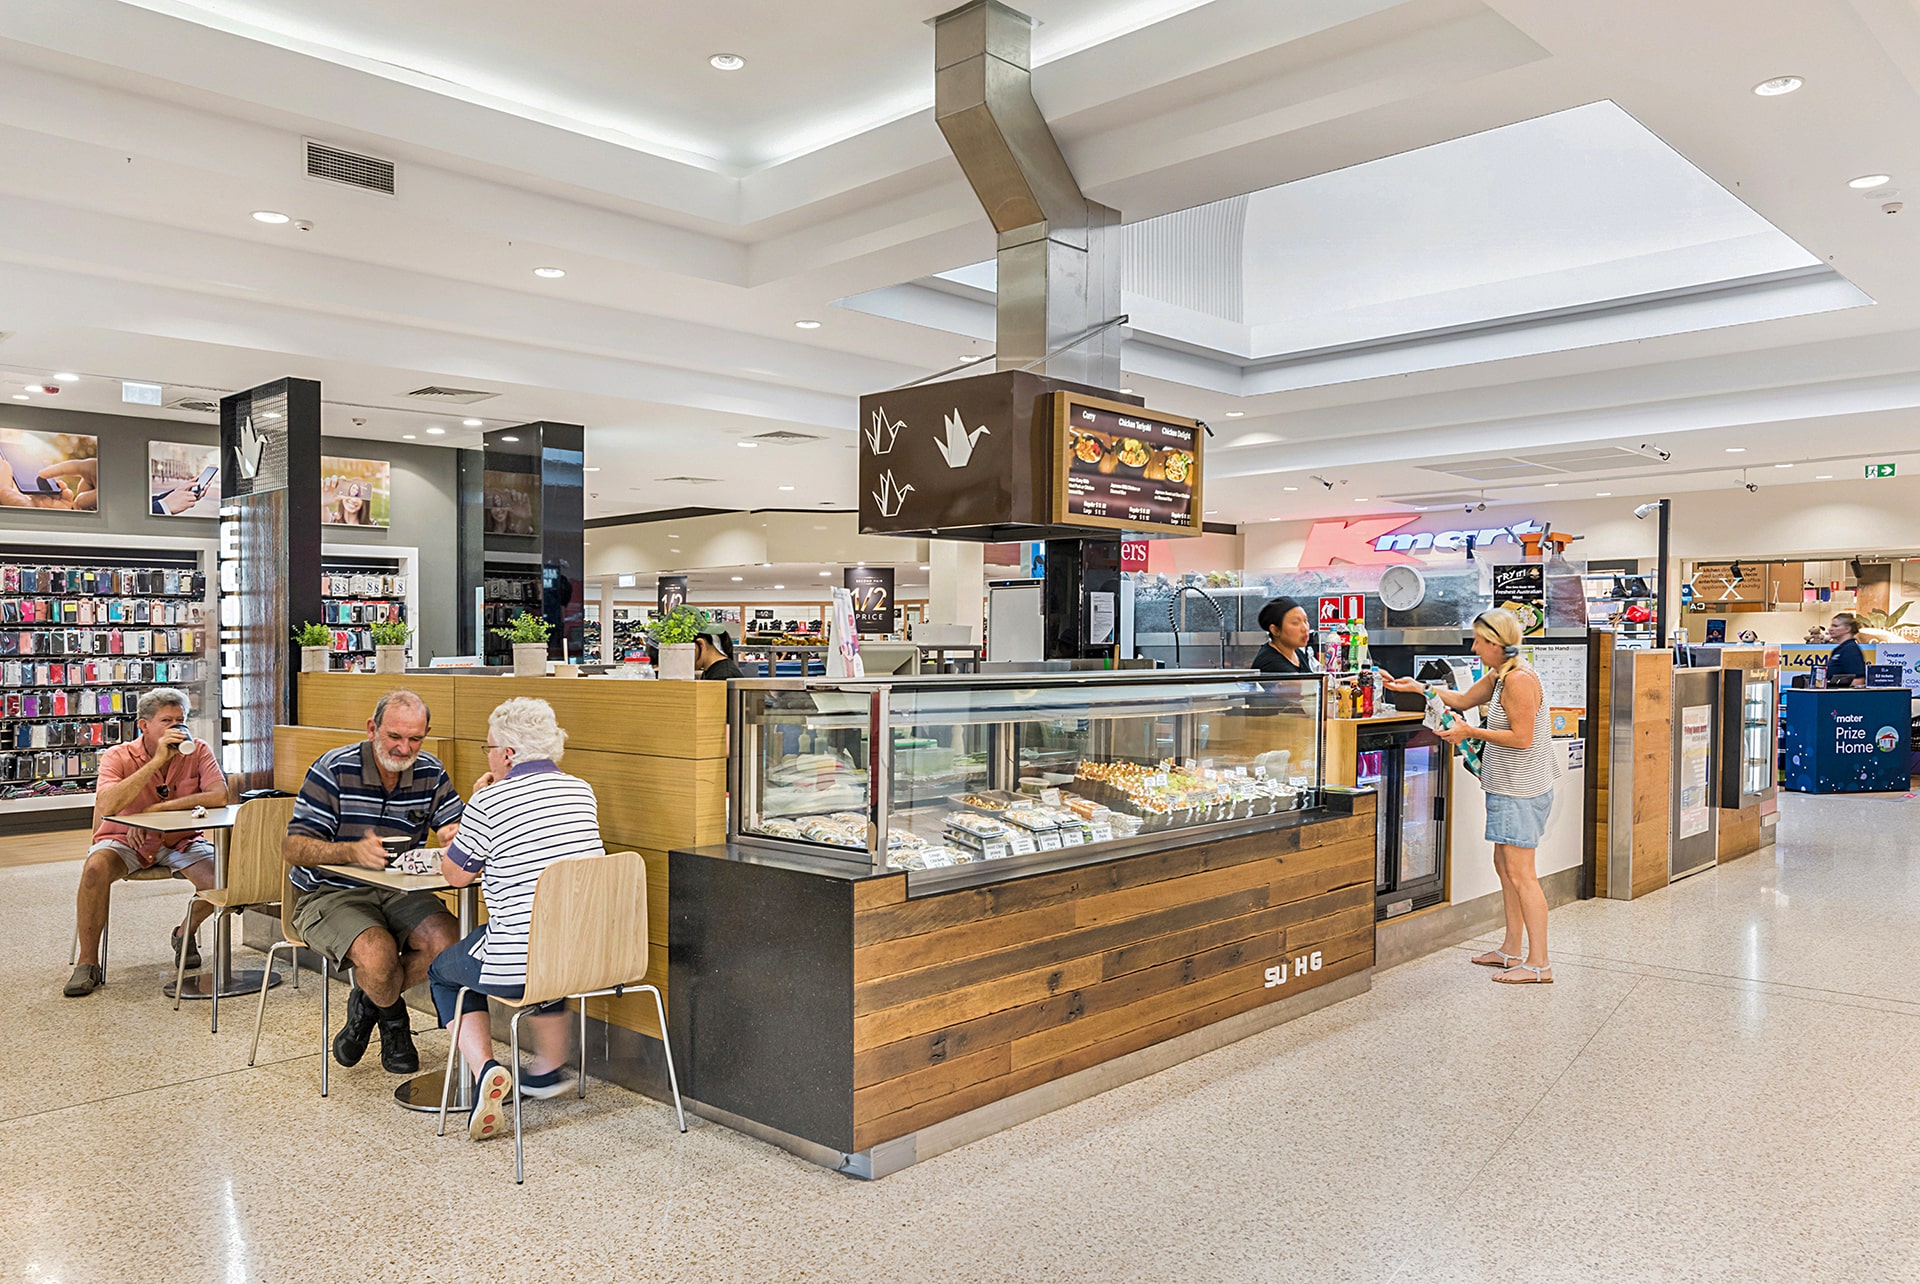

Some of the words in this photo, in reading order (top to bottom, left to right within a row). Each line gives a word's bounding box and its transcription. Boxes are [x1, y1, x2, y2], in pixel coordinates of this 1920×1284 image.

[1082, 410, 1096, 422] Curry
[1118, 418, 1136, 429] Chicken
[1161, 427, 1178, 437] Chicken
[1496, 570, 1516, 583] TRY
[850, 587, 887, 611] 1/2
[1836, 714, 1863, 723] mater
[1836, 727, 1866, 739] Prize
[1836, 741, 1874, 754] Home
